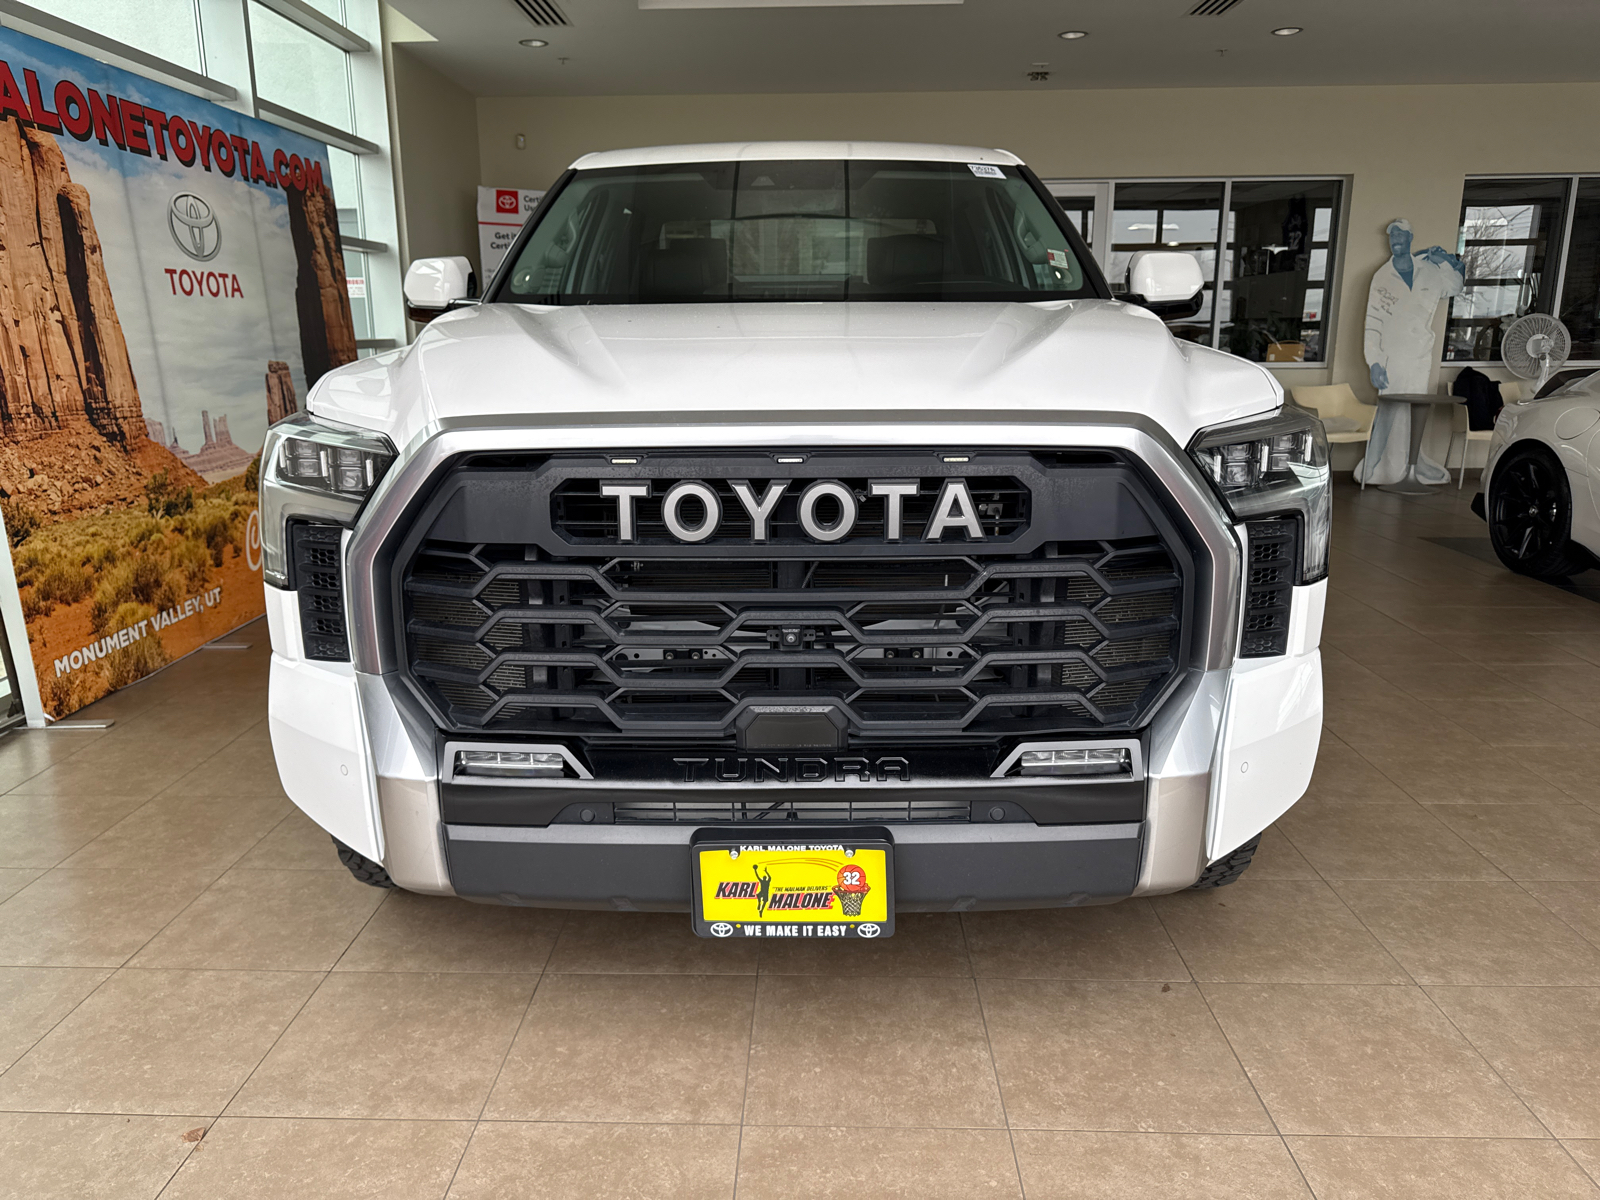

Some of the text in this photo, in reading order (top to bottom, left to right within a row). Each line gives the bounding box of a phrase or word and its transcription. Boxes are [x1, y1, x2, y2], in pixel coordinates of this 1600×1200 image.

[494, 232, 510, 240] Get
[164, 268, 244, 299] TOYOTA
[601, 481, 984, 542] TOYOTA
[54, 587, 222, 678] MONUMENT VALLEY, UT
[673, 757, 911, 782] TUNDRA
[843, 871, 861, 886] 32
[715, 881, 759, 899] KARL
[767, 892, 835, 910] MALONE
[743, 924, 847, 937] WE MAKE IT EASY
